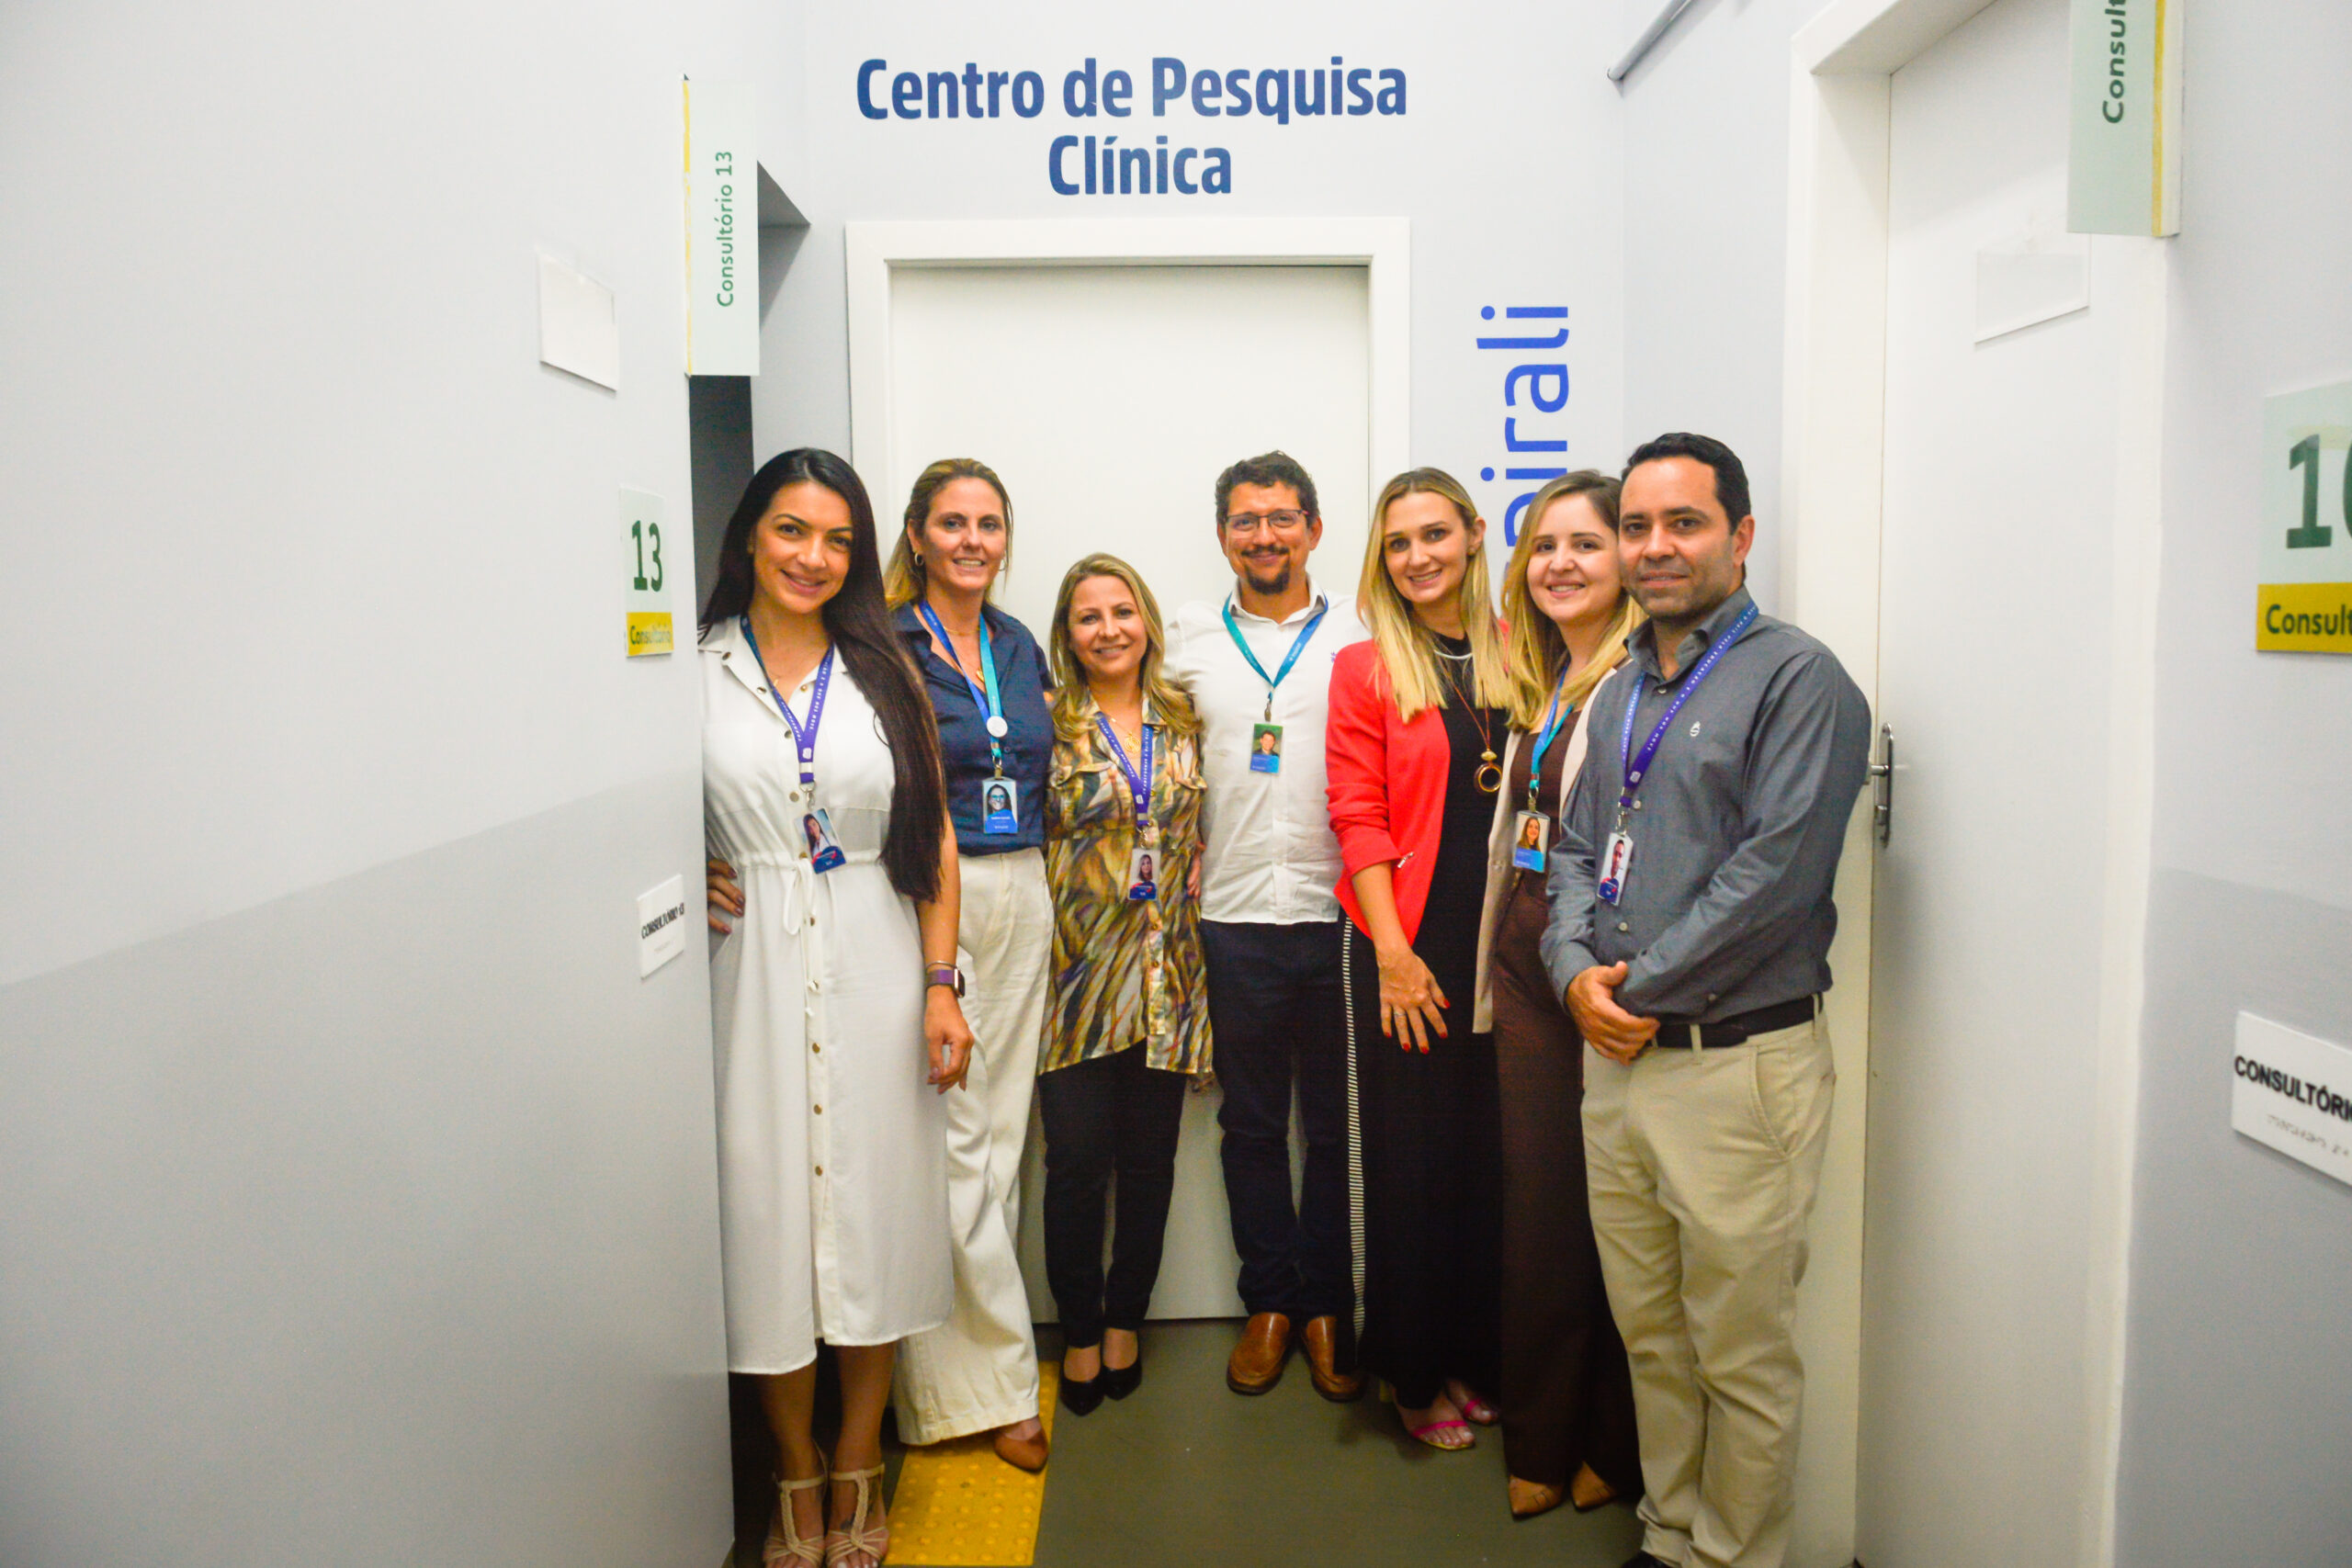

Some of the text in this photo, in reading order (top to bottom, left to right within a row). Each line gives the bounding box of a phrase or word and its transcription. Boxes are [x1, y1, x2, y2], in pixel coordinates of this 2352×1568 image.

[856, 56, 1407, 125] Centro de Pesquisa
[1049, 135, 1231, 196] Clínica
[715, 151, 733, 307] Consultório 13
[2286, 434, 2352, 549] 1
[631, 520, 663, 592] 13
